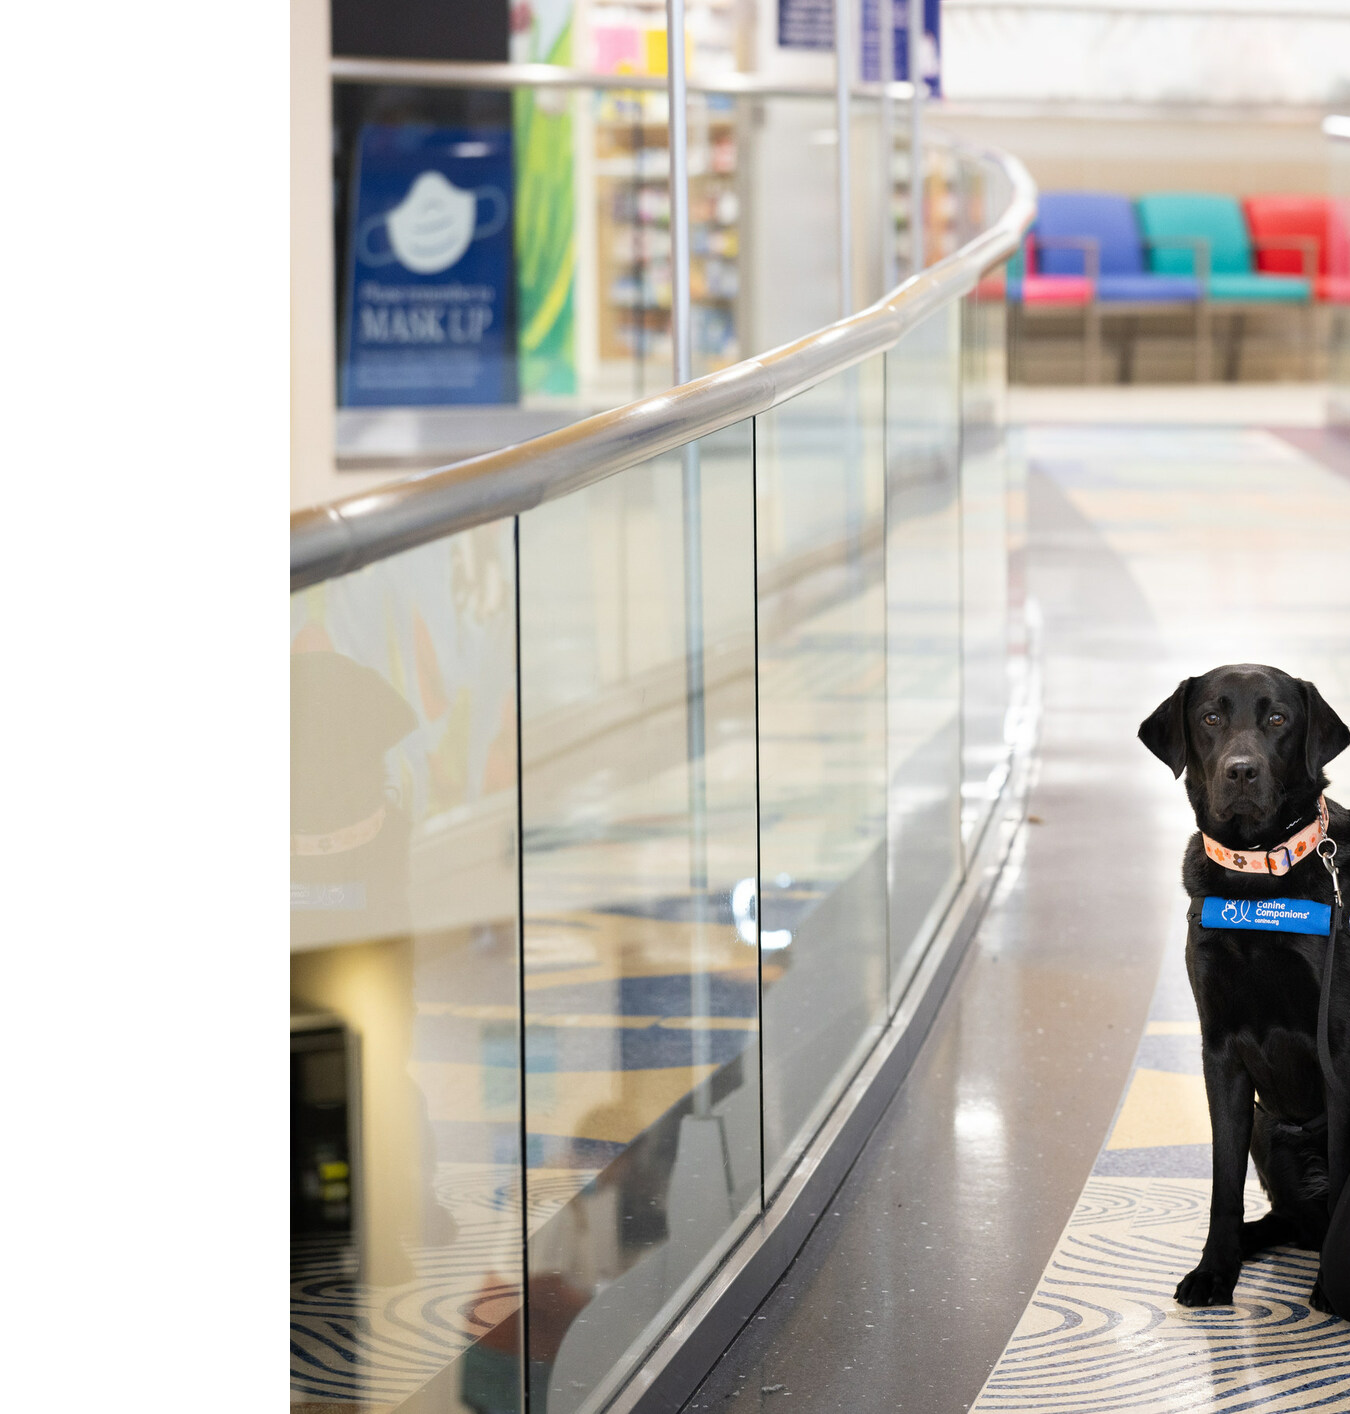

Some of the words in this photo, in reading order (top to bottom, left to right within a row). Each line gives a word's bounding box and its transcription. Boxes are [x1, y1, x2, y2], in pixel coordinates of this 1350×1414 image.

[360, 304, 445, 343] MASK
[448, 304, 493, 343] UP
[1256, 900, 1286, 910] Canine
[1254, 918, 1280, 926] canine.org
